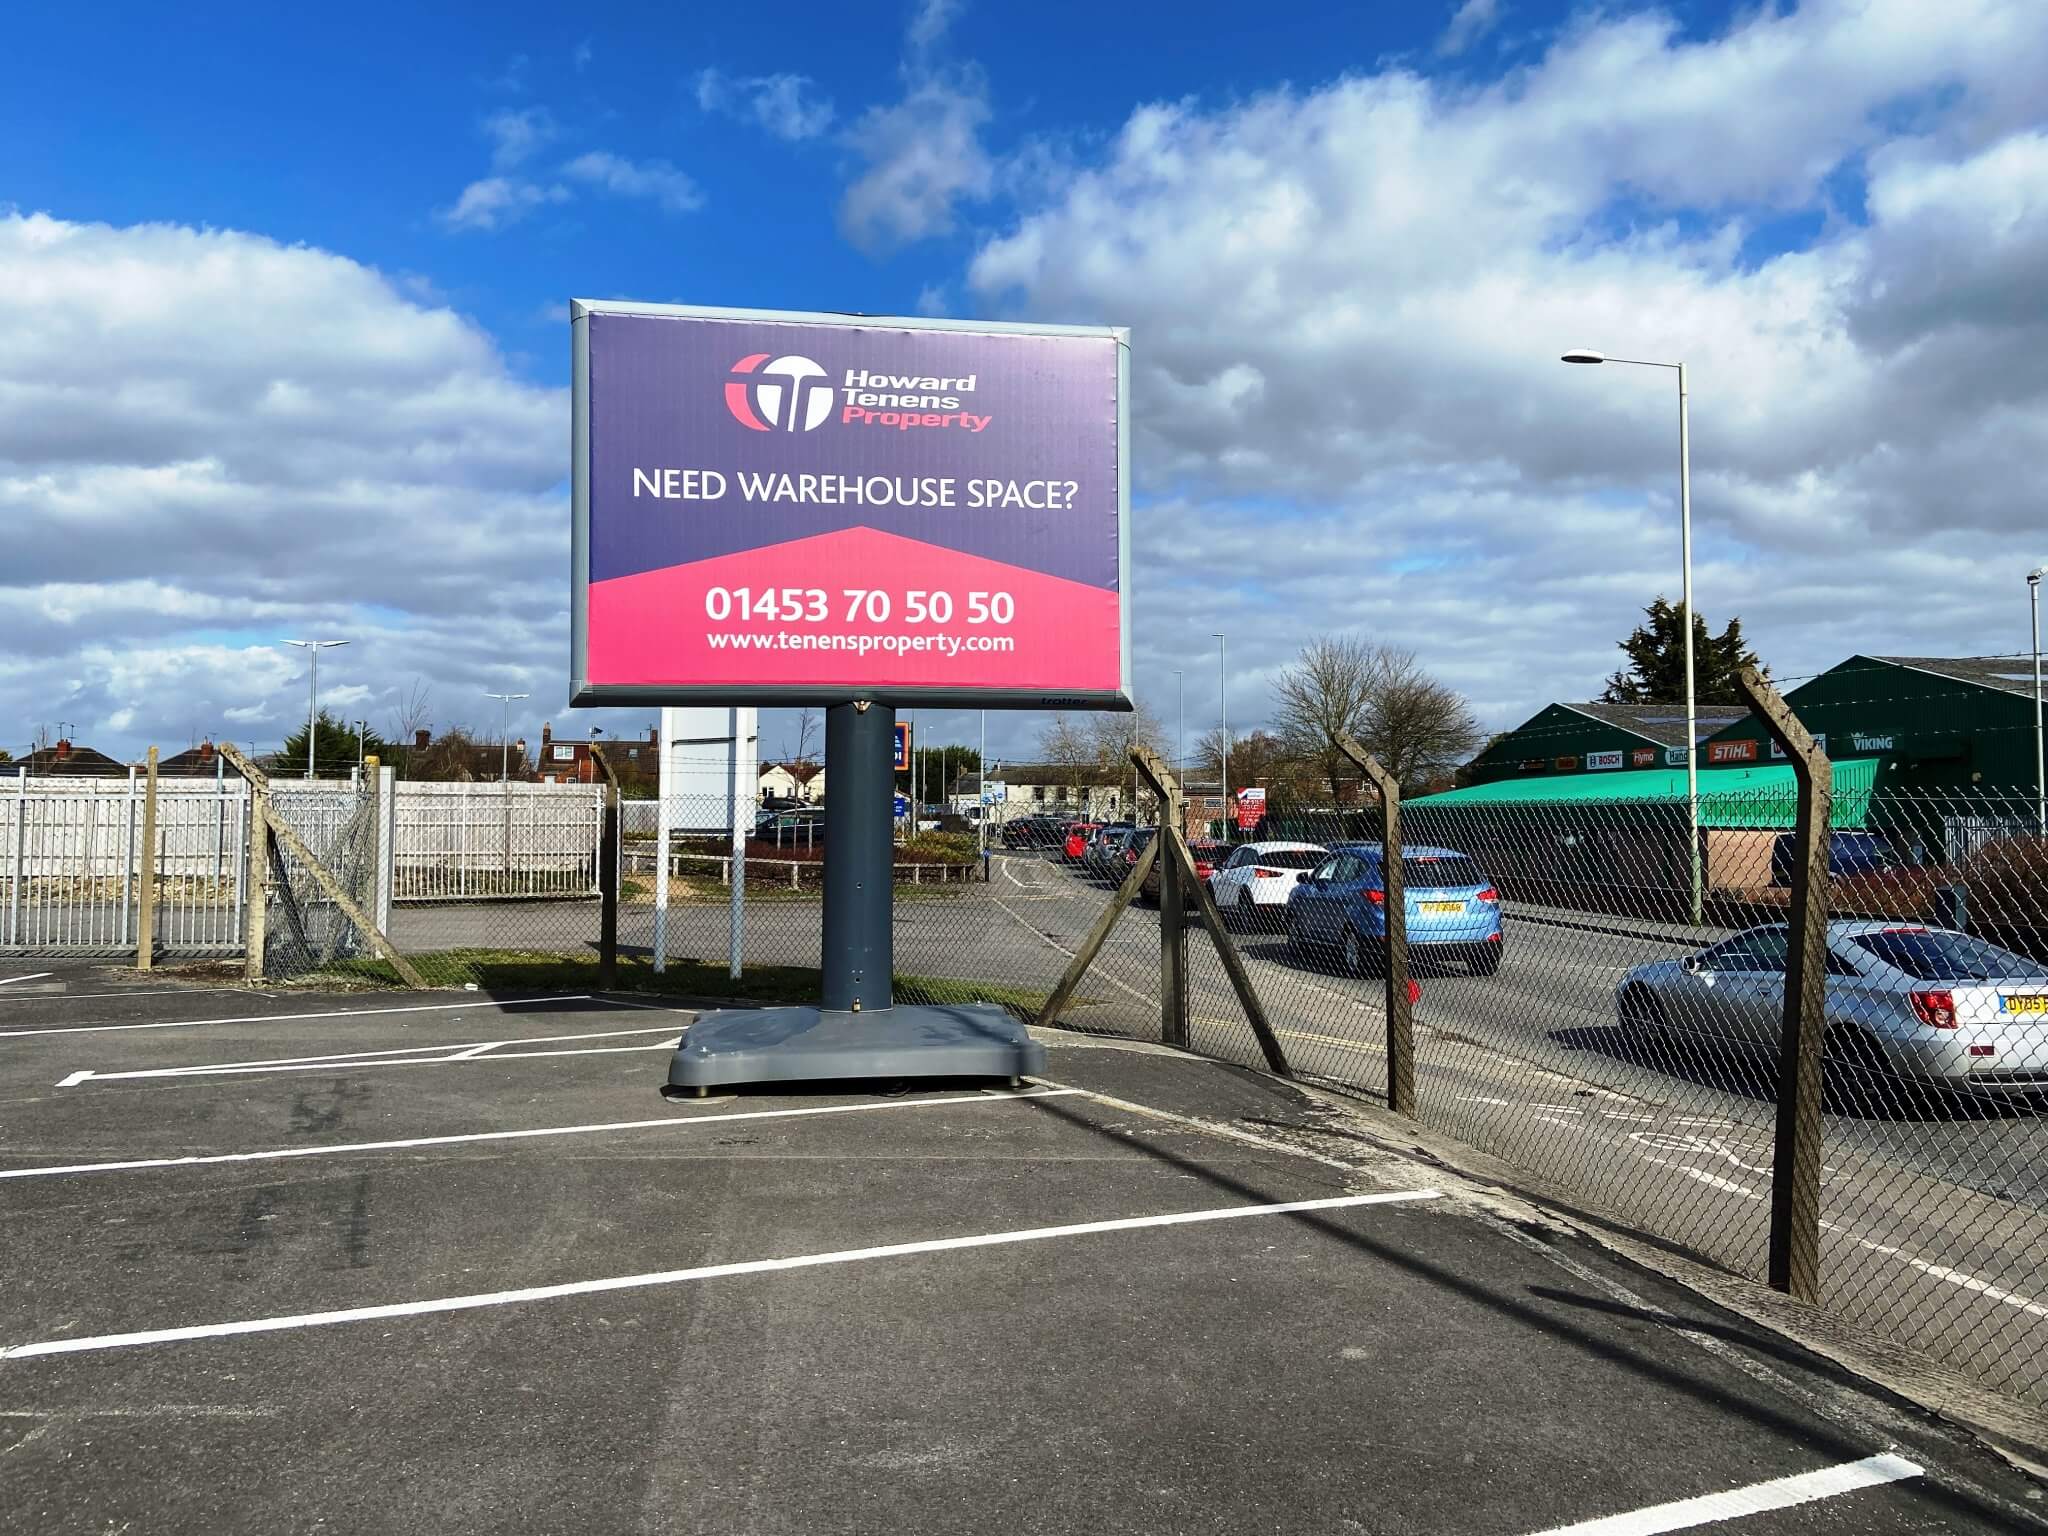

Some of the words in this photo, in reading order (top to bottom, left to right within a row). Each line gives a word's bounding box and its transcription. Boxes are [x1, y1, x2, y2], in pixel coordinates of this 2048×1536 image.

[844, 369, 977, 392] Howard
[841, 388, 960, 410] Tenens
[842, 406, 993, 432] Property
[633, 467, 727, 500] NEED
[736, 471, 956, 507] WAREHOUSE
[967, 479, 1079, 510] SPACE?
[705, 586, 829, 621] 01453
[843, 589, 891, 622] 70
[904, 590, 953, 624] 50
[967, 591, 1015, 625] 50
[707, 630, 1014, 657] www.tenensproperty.com
[1714, 744, 1750, 760] STIHL
[1854, 737, 1893, 751] VIKING
[1598, 754, 1620, 765] BOSCH
